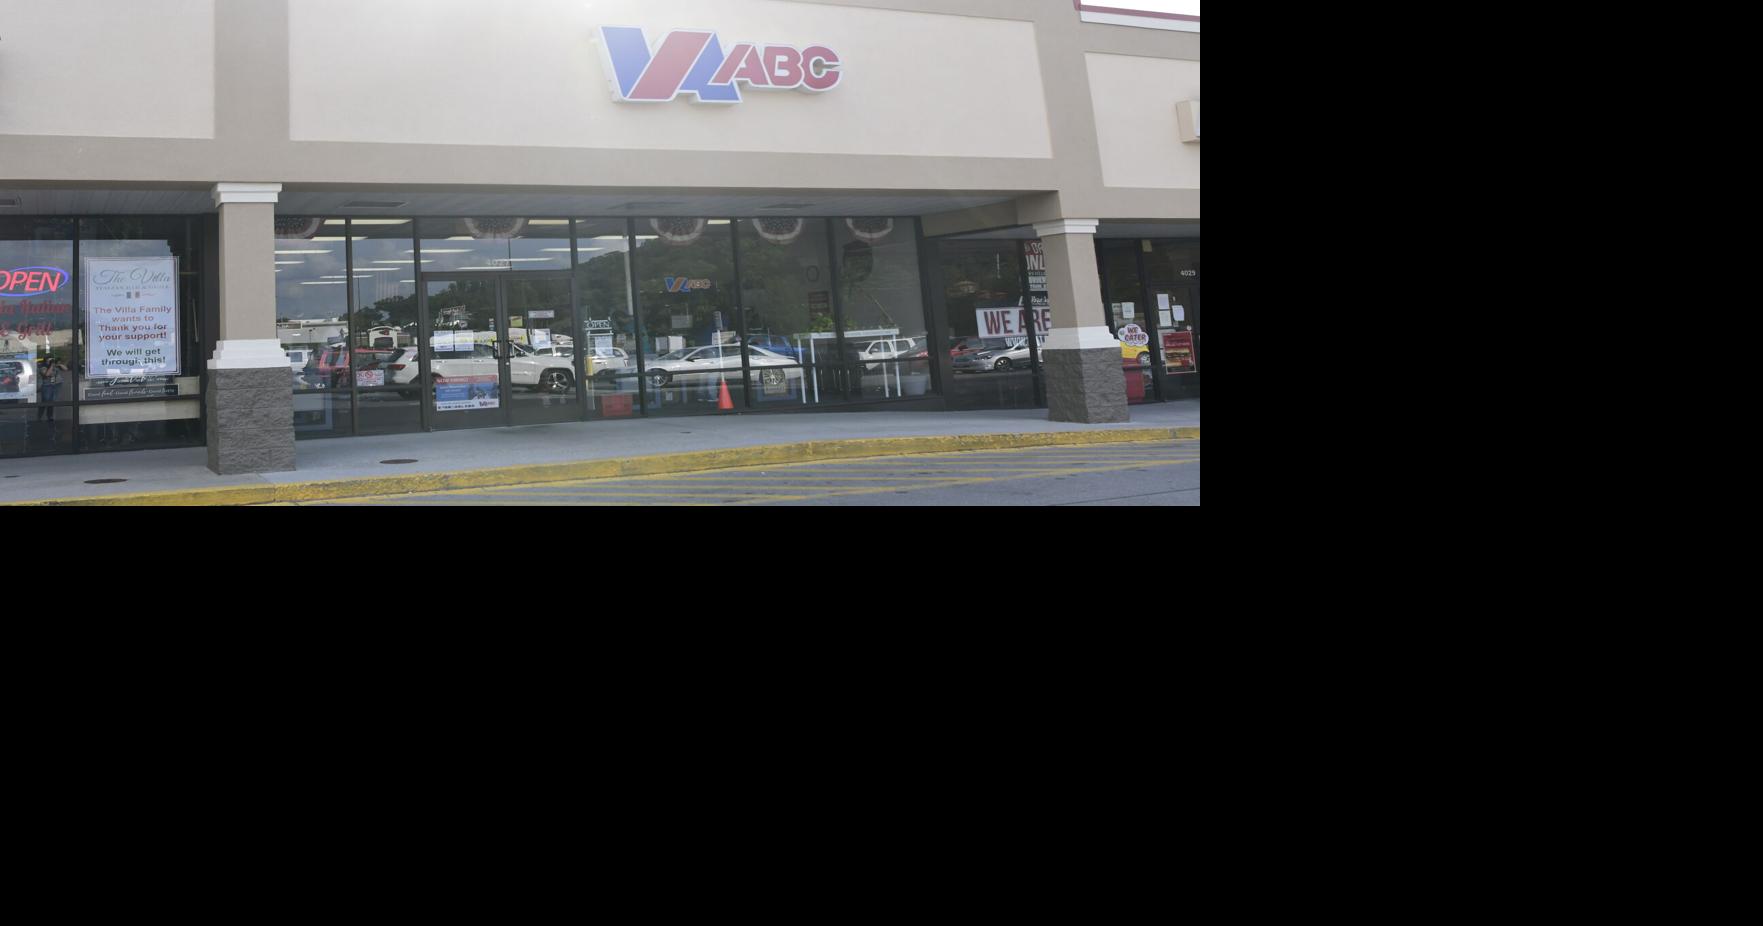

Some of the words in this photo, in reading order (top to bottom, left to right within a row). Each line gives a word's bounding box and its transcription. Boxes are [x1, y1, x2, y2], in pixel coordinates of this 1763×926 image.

[706, 43, 841, 90] ABC
[0, 269, 61, 292] OPEN
[130, 267, 170, 285] Villa
[95, 306, 112, 314] The
[115, 305, 136, 313] Villa
[139, 305, 172, 314] Family
[586, 321, 610, 329] OPEN
[983, 310, 1014, 335] WE
[1017, 308, 1050, 334] ARE
[99, 324, 129, 332] Thank
[98, 334, 122, 342] your
[125, 331, 167, 340] support!
[1124, 334, 1147, 342] CATER
[145, 348, 161, 356] get
[144, 356, 166, 364] this!
